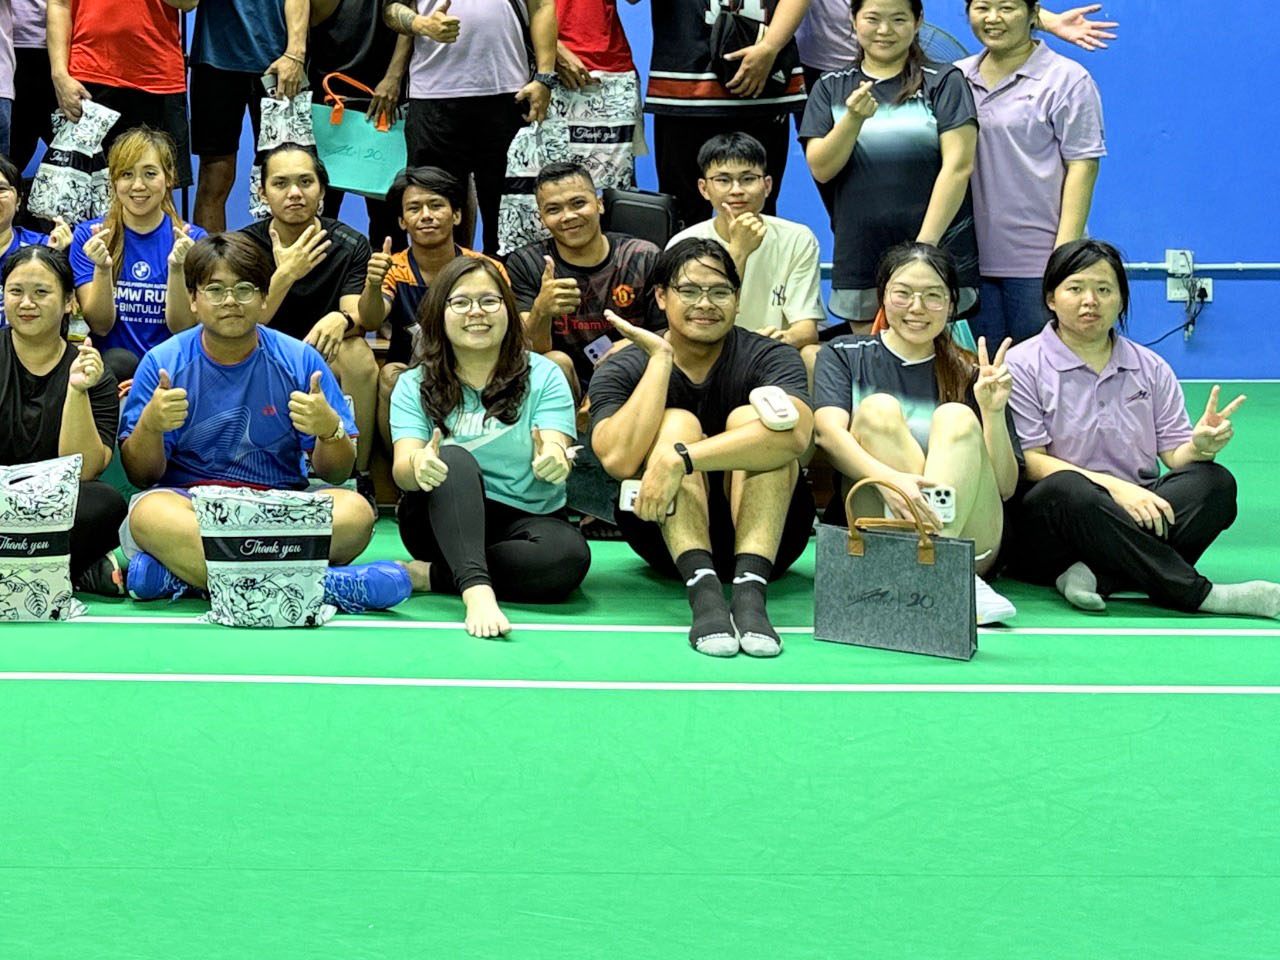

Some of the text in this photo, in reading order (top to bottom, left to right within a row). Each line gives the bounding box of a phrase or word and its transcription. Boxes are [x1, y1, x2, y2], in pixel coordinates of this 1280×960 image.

[144, 289, 167, 303] RU
[27, 541, 50, 555] you
[240, 539, 301, 559] Thank you
